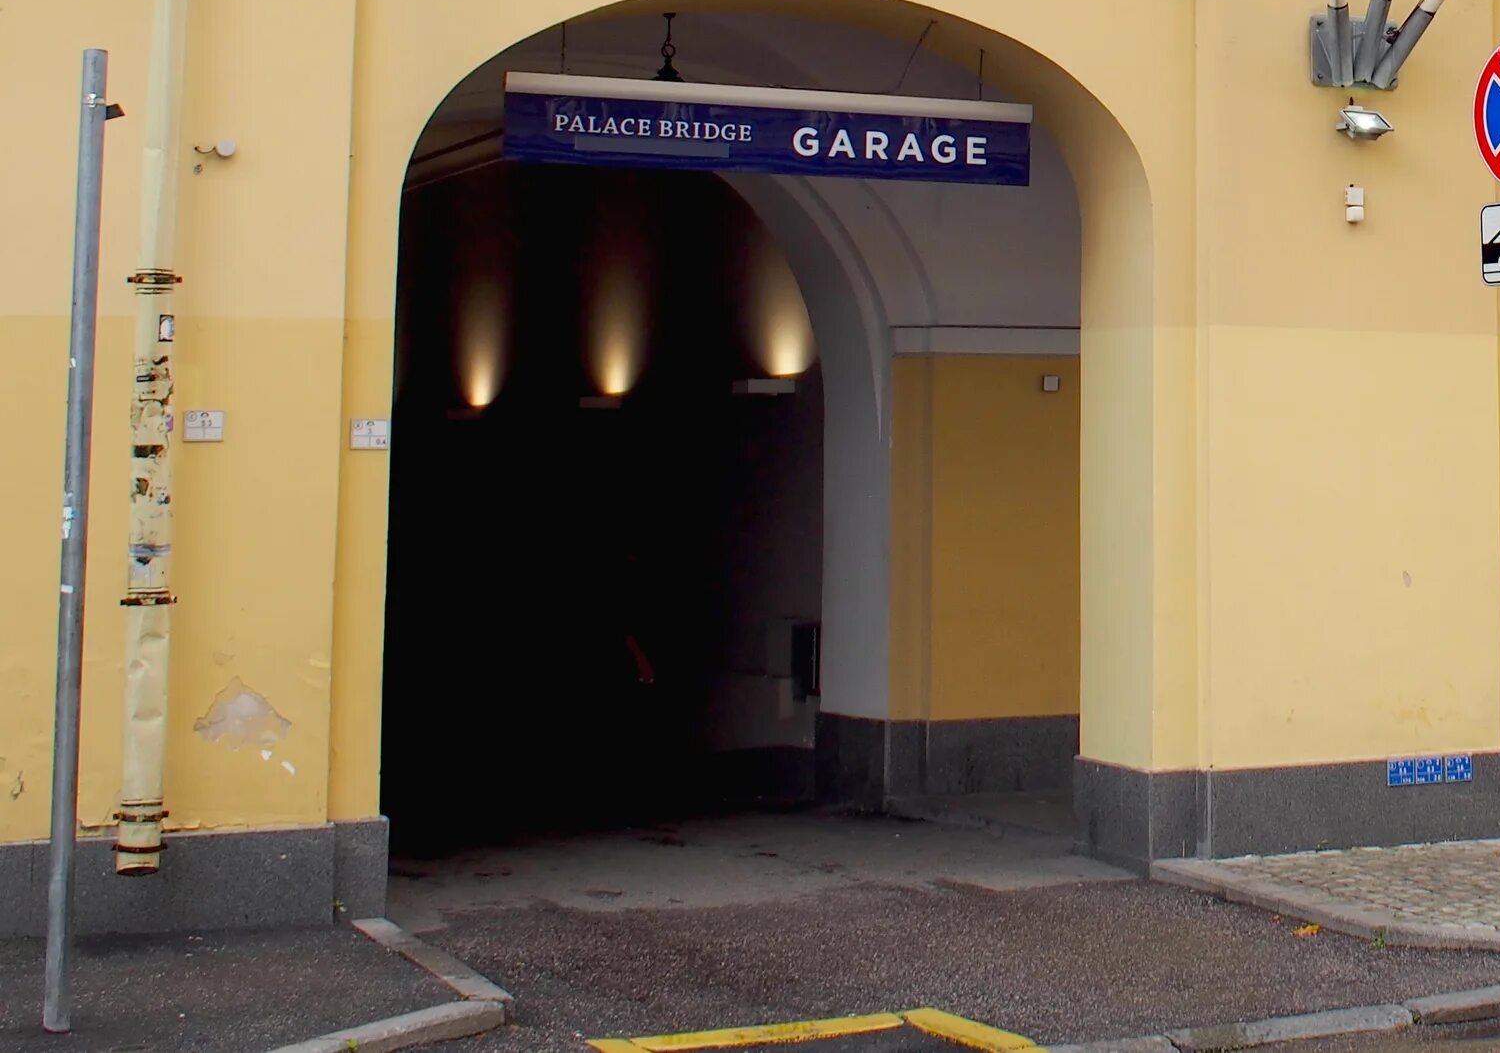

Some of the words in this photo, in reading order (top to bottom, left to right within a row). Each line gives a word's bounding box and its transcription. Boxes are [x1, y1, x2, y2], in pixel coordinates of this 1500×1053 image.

[554, 113, 651, 137] PALACE
[658, 119, 753, 143] BRIDGE
[792, 126, 988, 165] GARAGE
